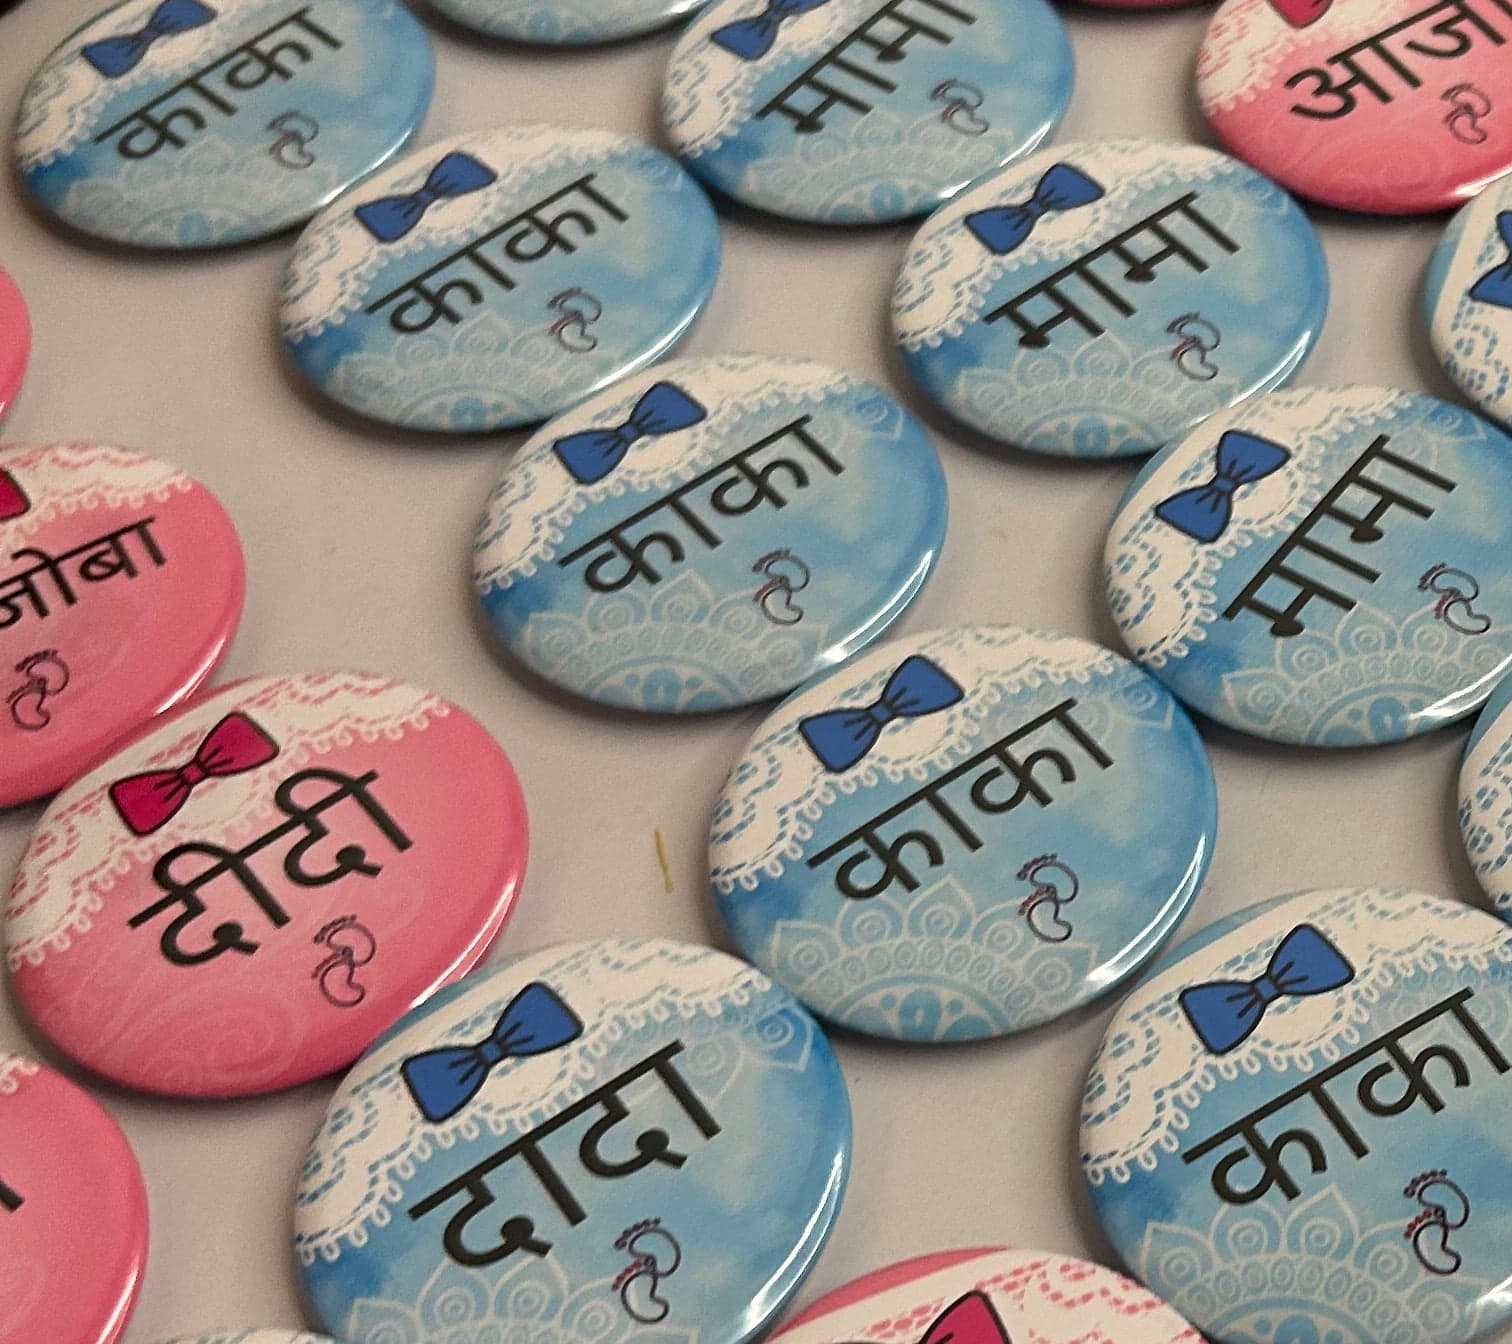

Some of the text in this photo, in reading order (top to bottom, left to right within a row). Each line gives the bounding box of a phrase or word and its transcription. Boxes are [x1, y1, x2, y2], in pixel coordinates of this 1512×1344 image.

[93, 6, 346, 164] काका
[363, 172, 631, 337] काका
[984, 191, 1241, 350] मामा
[0, 515, 169, 631] जोबा
[559, 413, 846, 595] काका
[1222, 434, 1457, 638] मामा
[126, 767, 414, 966] दीदी
[806, 697, 1116, 900] काका
[408, 1040, 723, 1268] दादा
[1182, 987, 1512, 1208] काका
